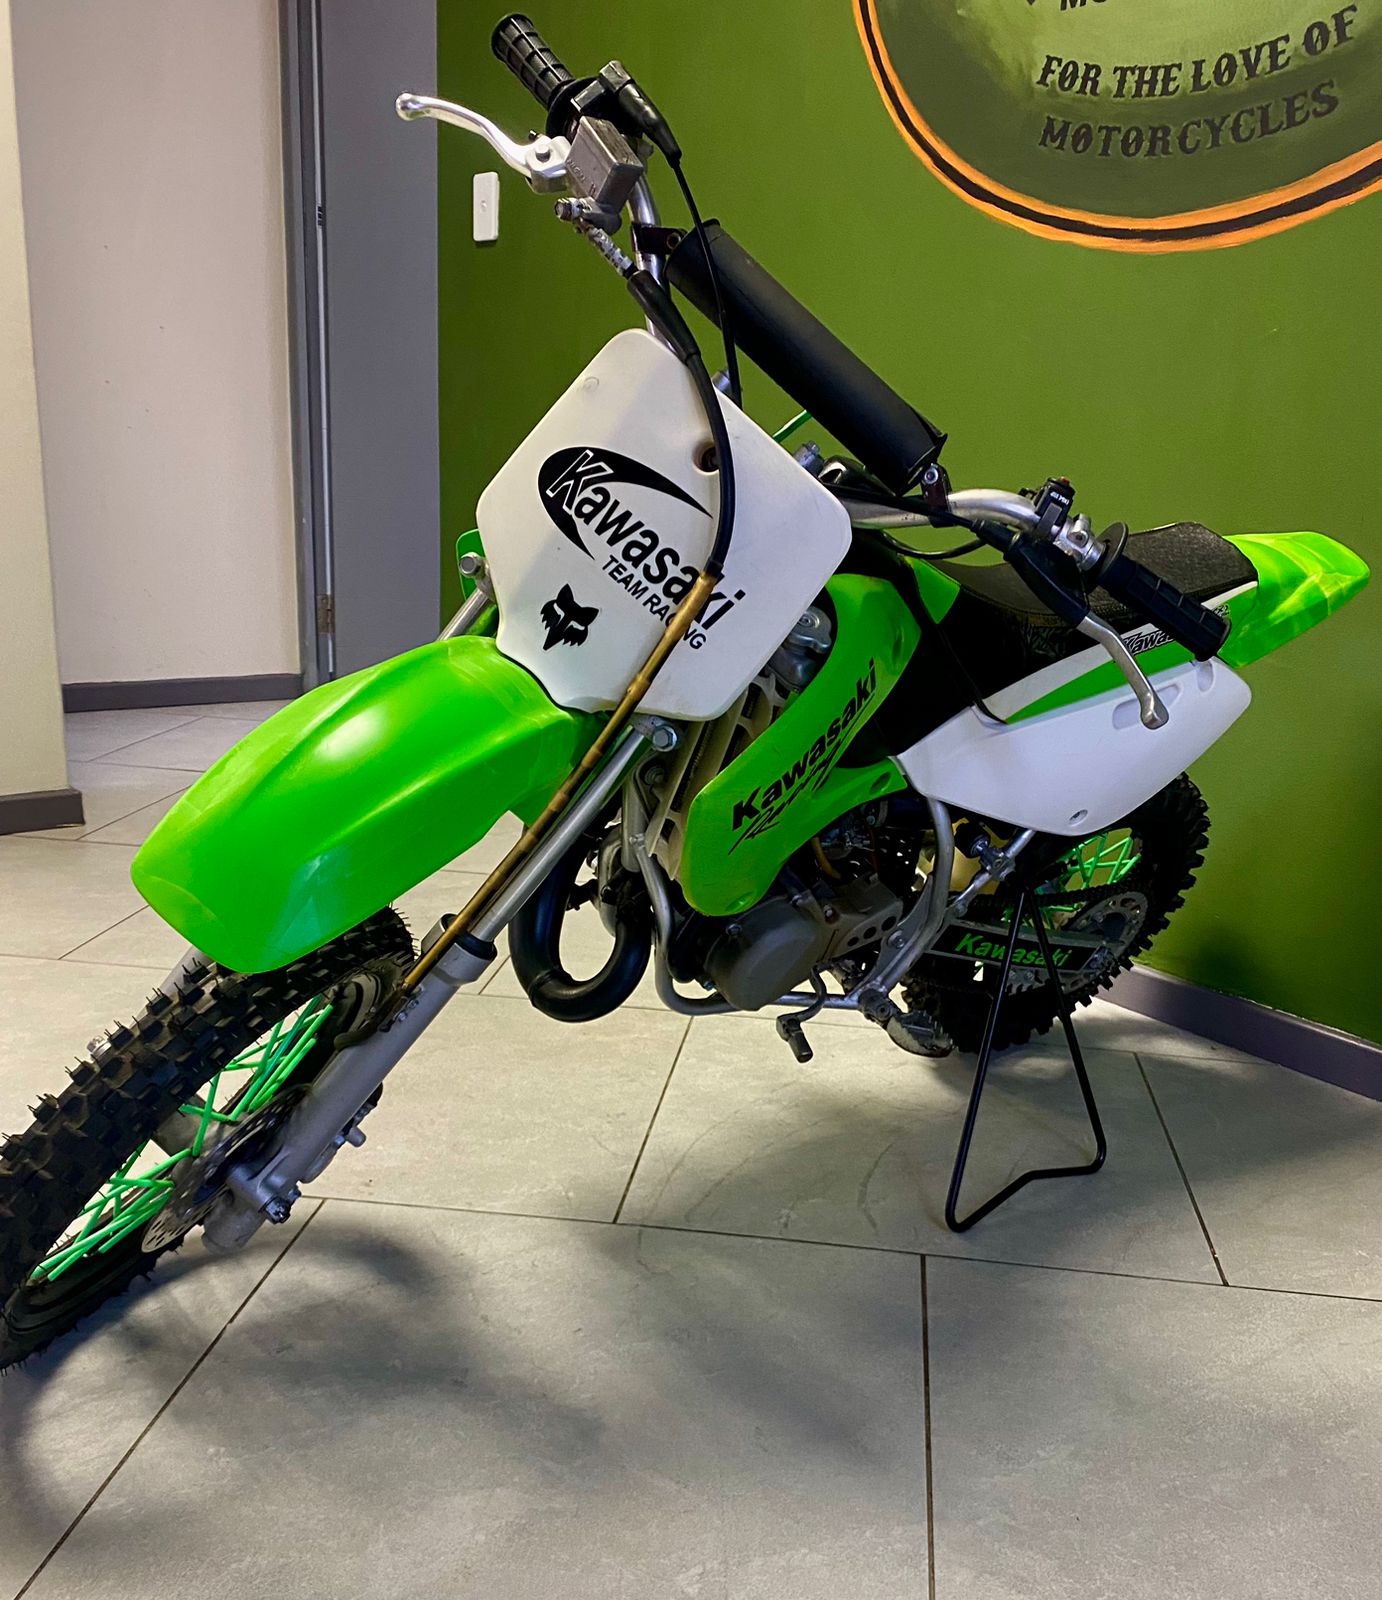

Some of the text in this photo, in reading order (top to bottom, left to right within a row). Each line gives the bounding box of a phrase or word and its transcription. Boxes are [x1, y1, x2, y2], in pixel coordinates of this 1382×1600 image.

[1036, 4, 1358, 98] FOR THE LOVE OF
[1038, 79, 1340, 158] MOTORCYCLES
[601, 554, 707, 650] TEAM RANG
[732, 656, 877, 832] Kawasaki
